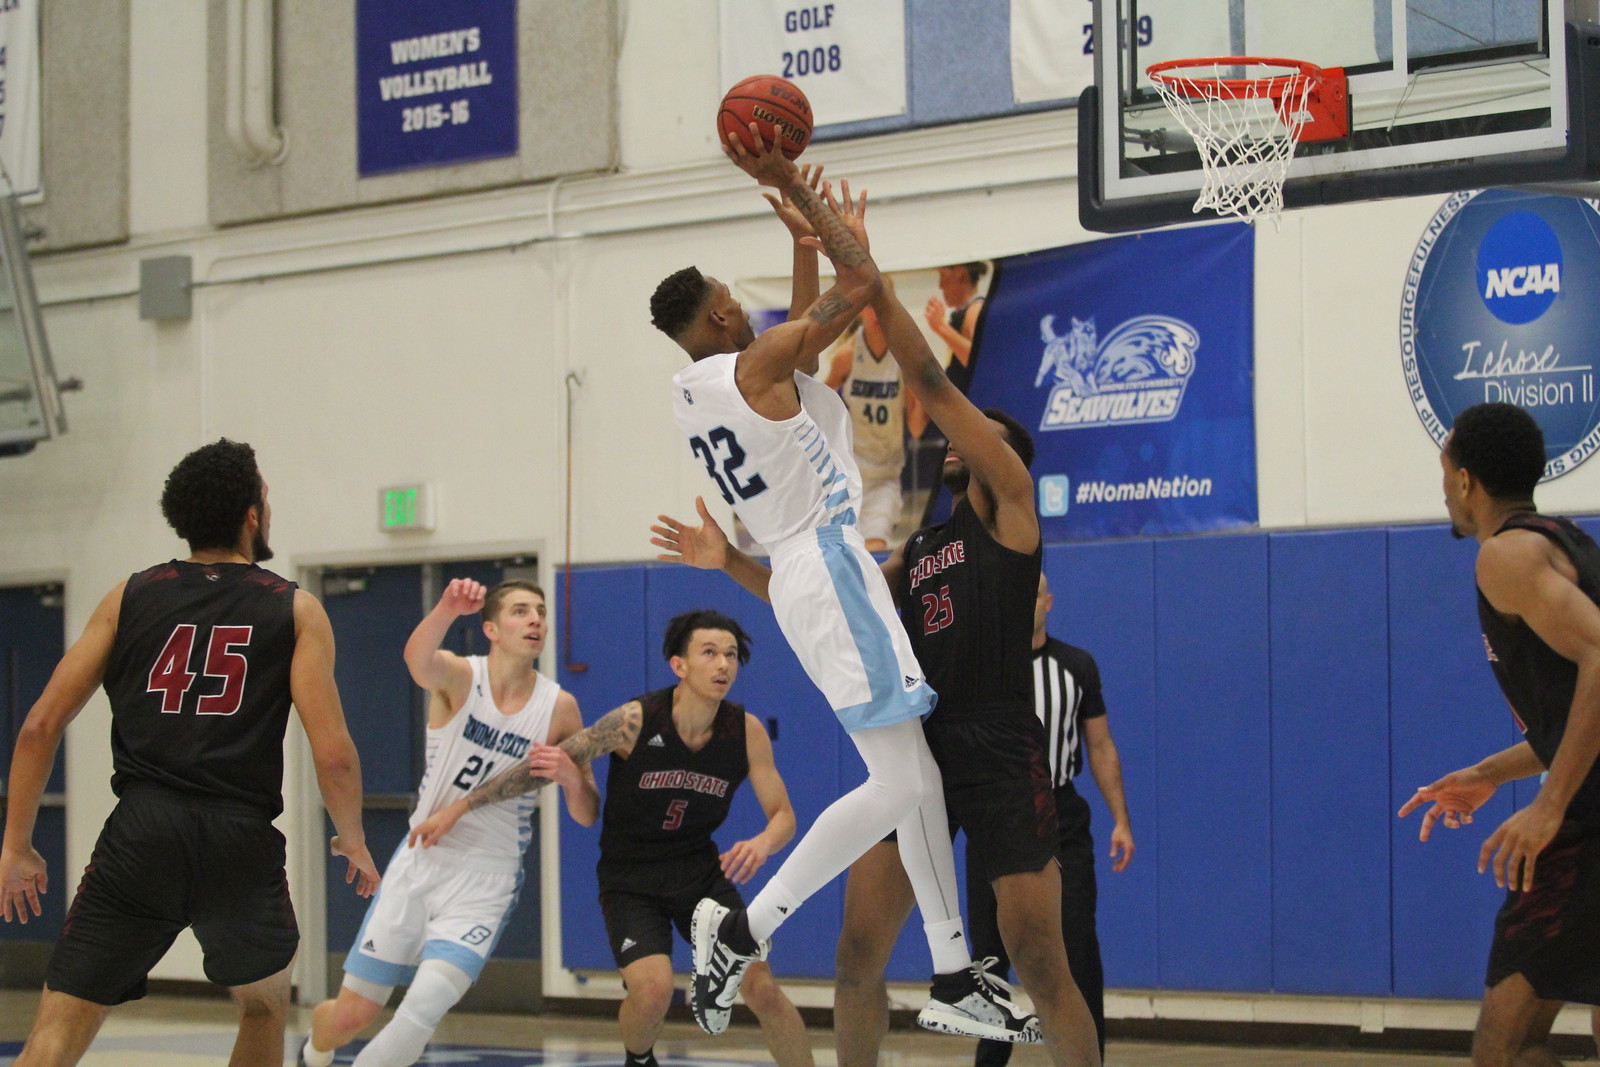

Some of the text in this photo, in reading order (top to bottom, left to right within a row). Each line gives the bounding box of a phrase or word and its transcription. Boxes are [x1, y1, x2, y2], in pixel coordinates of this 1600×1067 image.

[785, 4, 834, 33] GOLF
[1083, 15, 1153, 55] 29
[390, 27, 481, 65] WOMEN'S
[782, 45, 841, 78] 2008
[379, 61, 493, 101] VOLLEYBALL
[402, 99, 470, 133] 2015-16
[1401, 190, 1470, 402] RESOURCEFULNESS
[1485, 263, 1560, 299] NCAA
[1046, 388, 1181, 425] SEAWOLVES
[1484, 380, 1574, 407] Division
[863, 403, 888, 425] 40
[689, 425, 769, 506] 32
[1076, 474, 1212, 504] #NomaNation
[922, 585, 954, 636] 25
[146, 624, 253, 716] 45
[453, 755, 494, 791] 21
[639, 770, 729, 798] CHICO STATE
[662, 800, 688, 830] 5
